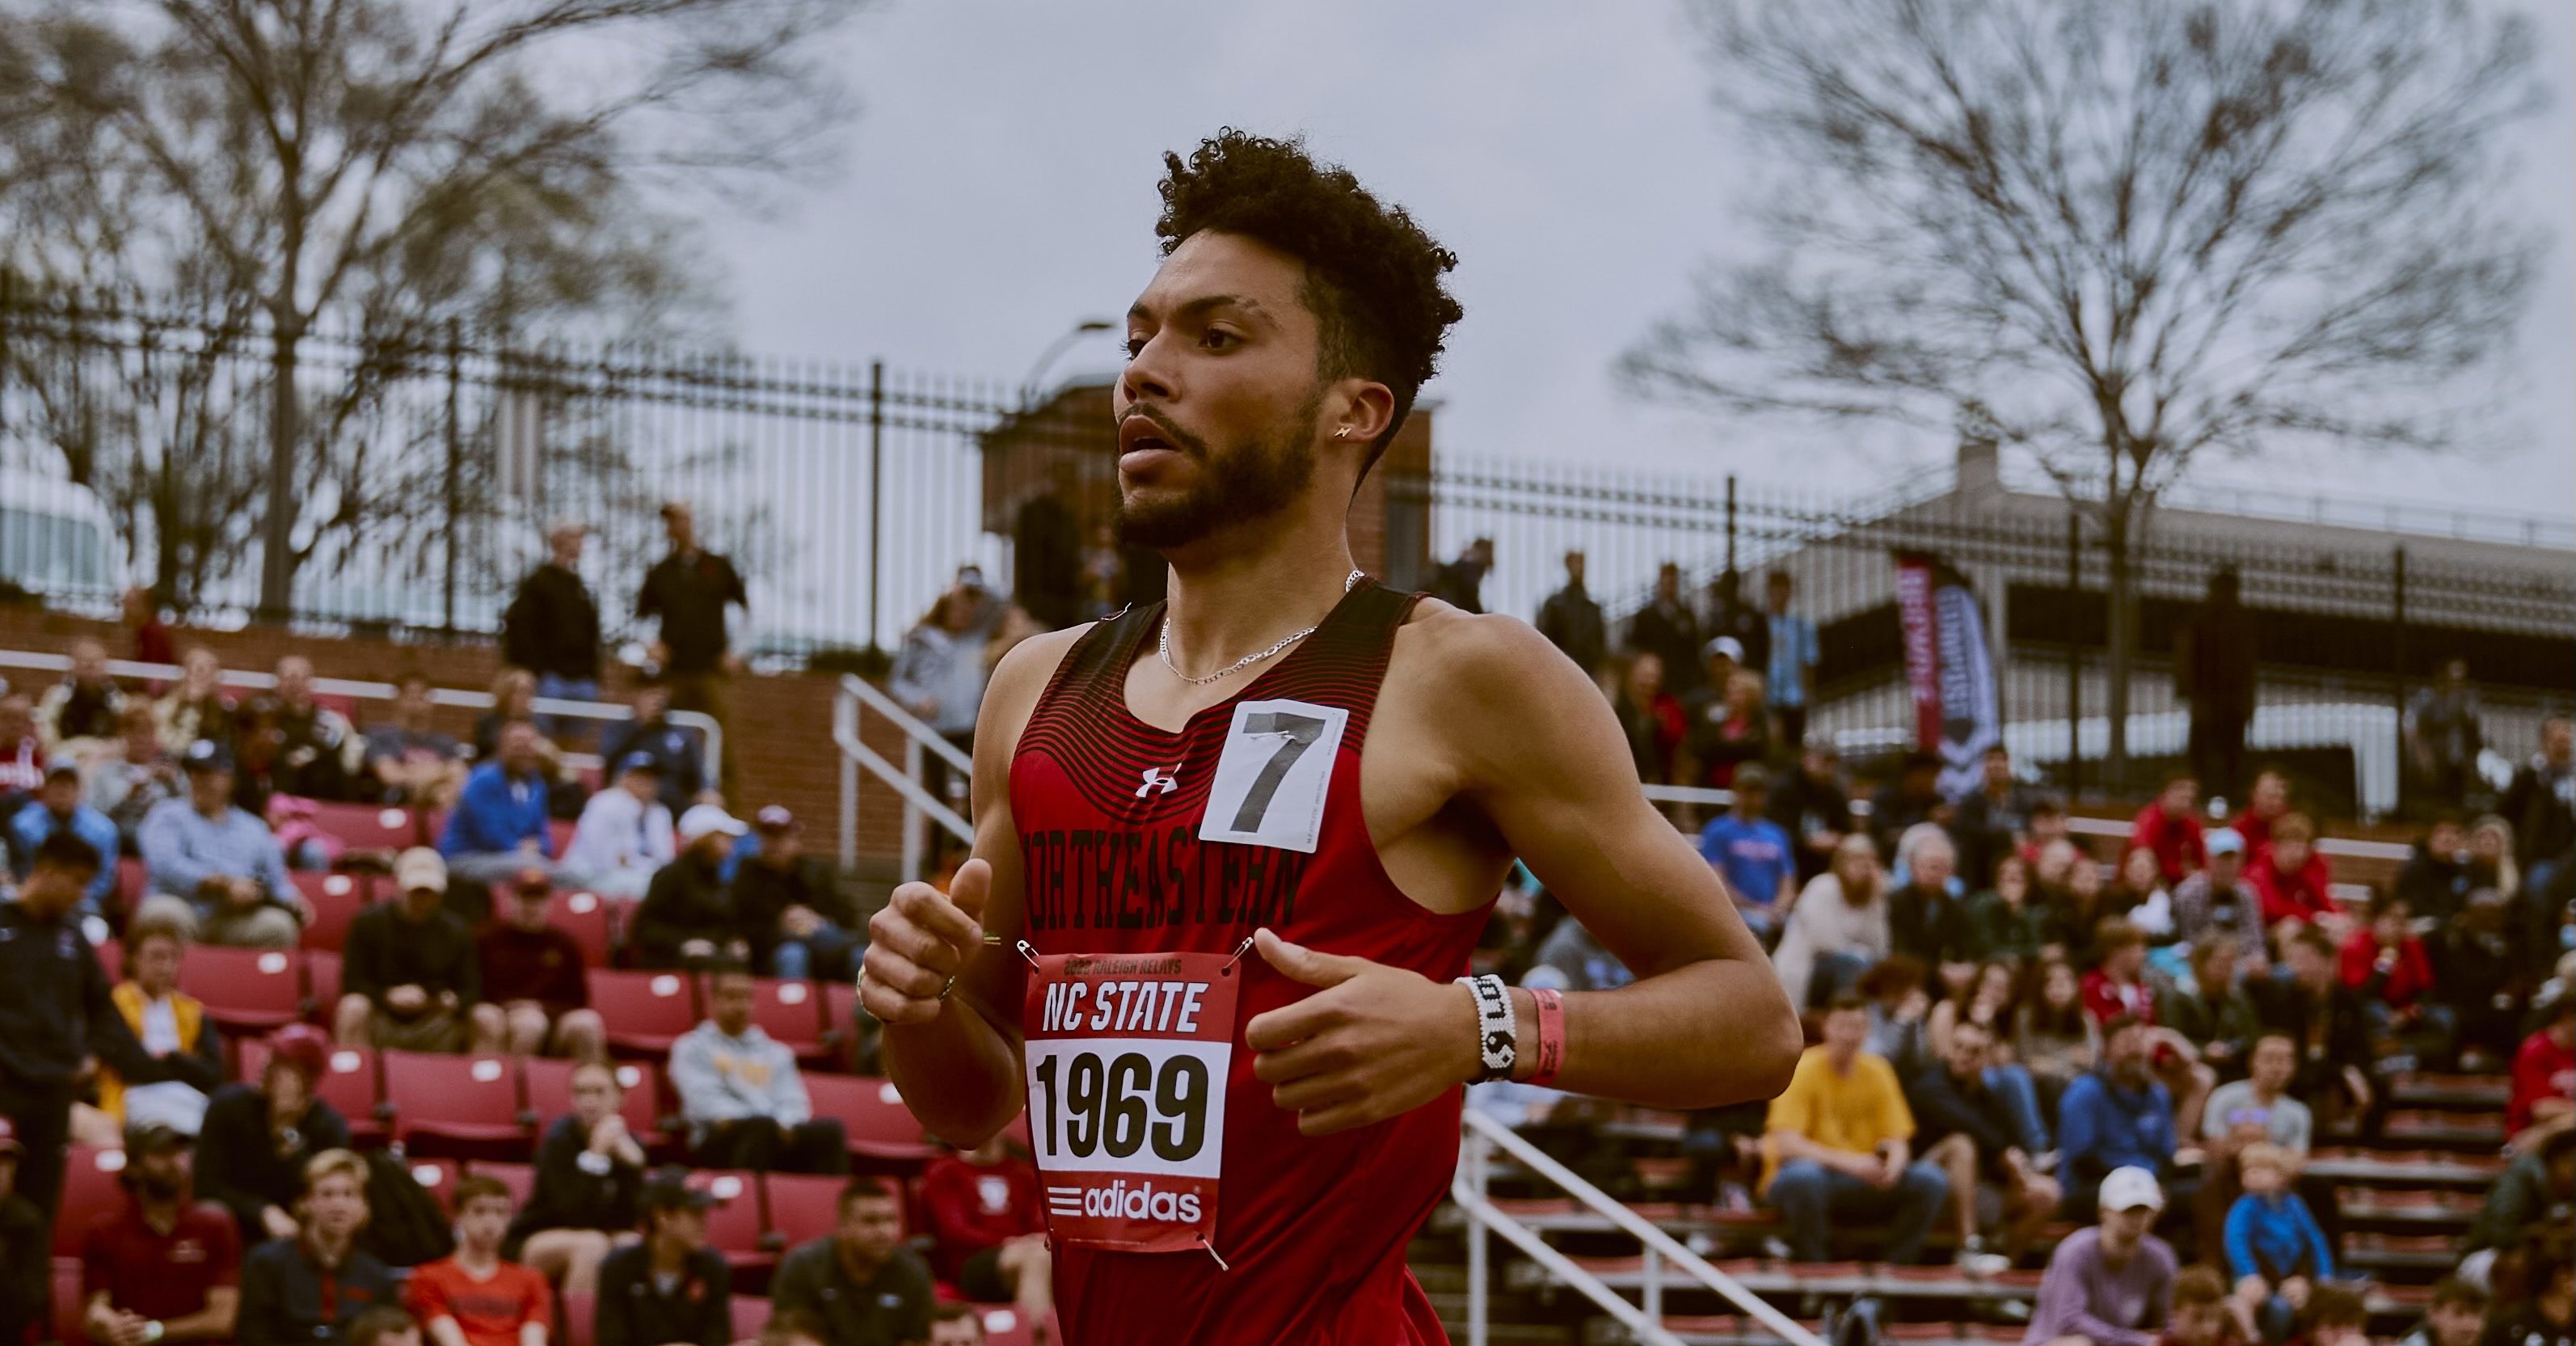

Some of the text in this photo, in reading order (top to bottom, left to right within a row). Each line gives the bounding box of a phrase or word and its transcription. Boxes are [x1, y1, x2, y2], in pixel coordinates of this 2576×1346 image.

[1229, 712, 1326, 833] 7
[1091, 959, 1138, 975] RALEIGH
[1139, 959, 1182, 974] RELAYS
[1042, 981, 1209, 1033] NC STATE
[1036, 1052, 1209, 1162] 1969
[1085, 1179, 1202, 1223] adidas
